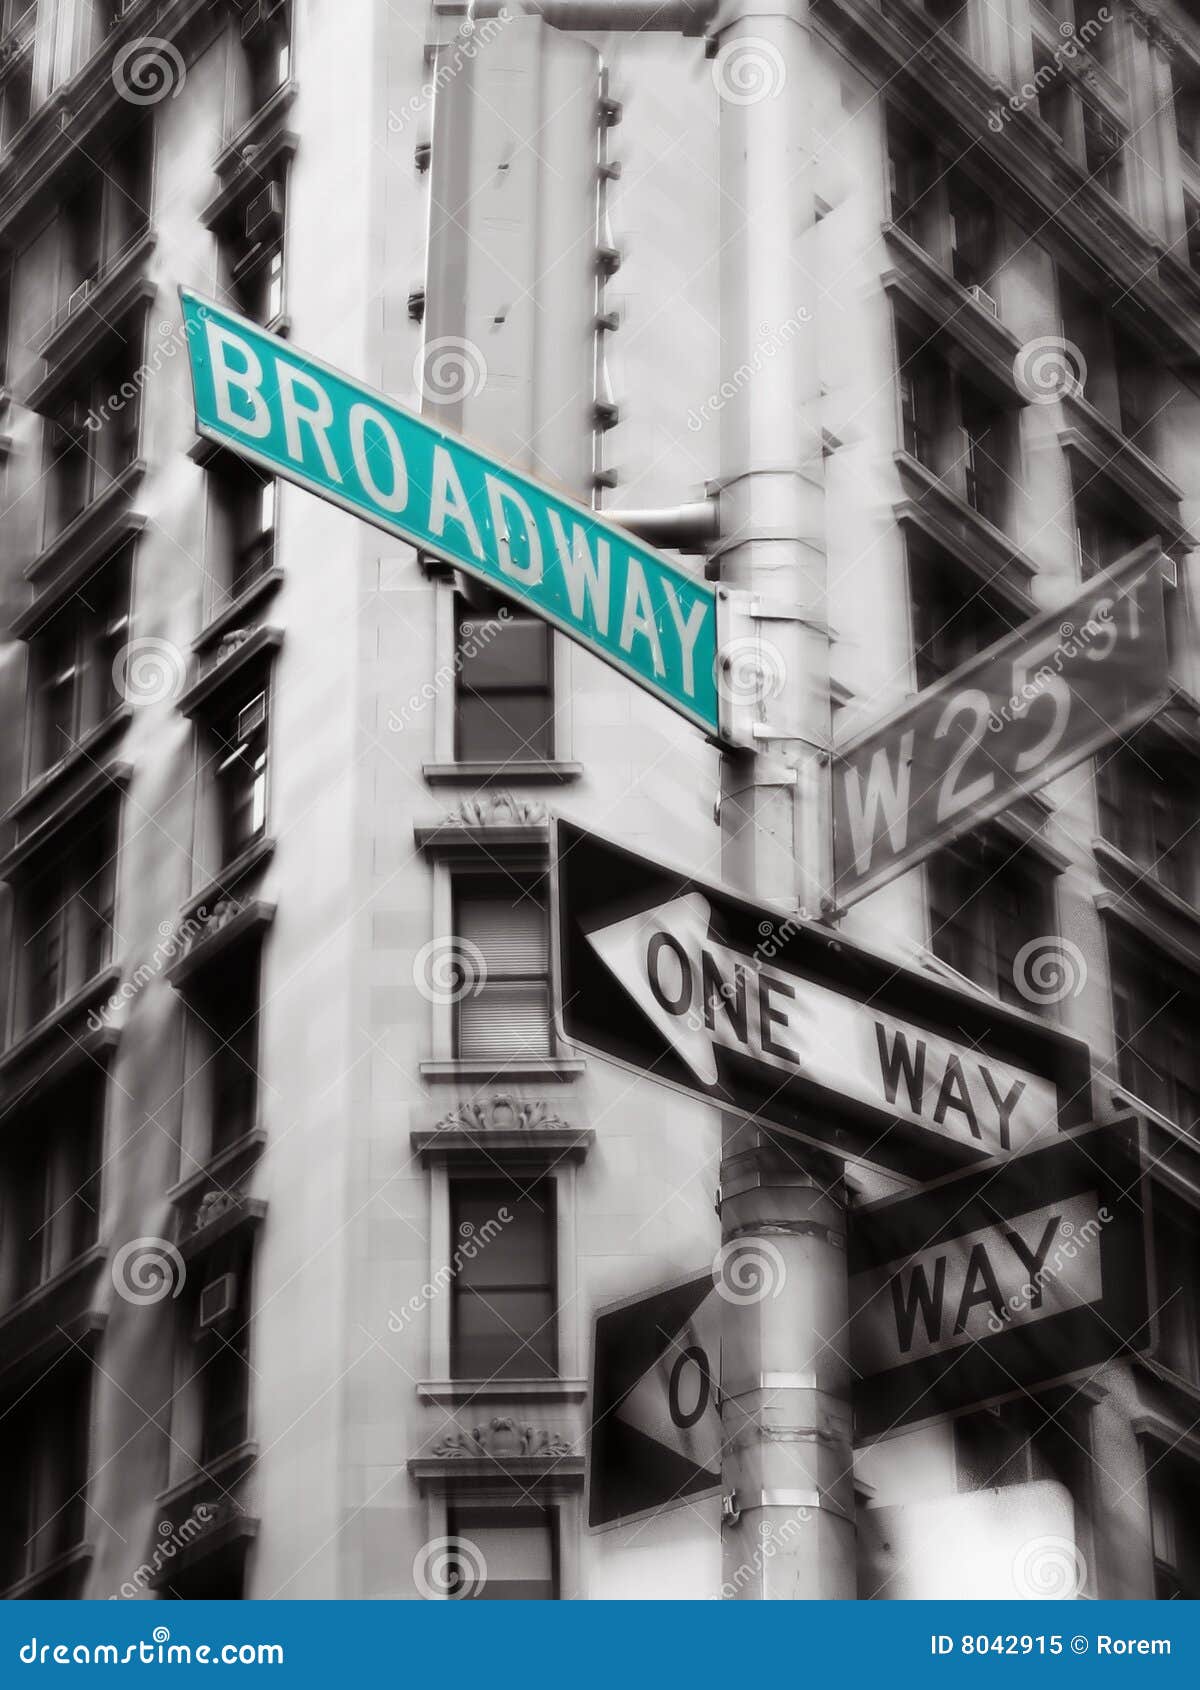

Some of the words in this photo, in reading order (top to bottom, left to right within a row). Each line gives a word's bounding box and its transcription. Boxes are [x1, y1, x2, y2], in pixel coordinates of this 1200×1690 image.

[204, 316, 707, 698] BROADWAY
[843, 730, 914, 876] W
[937, 631, 1071, 823] 25
[646, 931, 801, 1065] ONE
[874, 1021, 1027, 1151] WAY
[890, 1215, 1062, 1353] WAY
